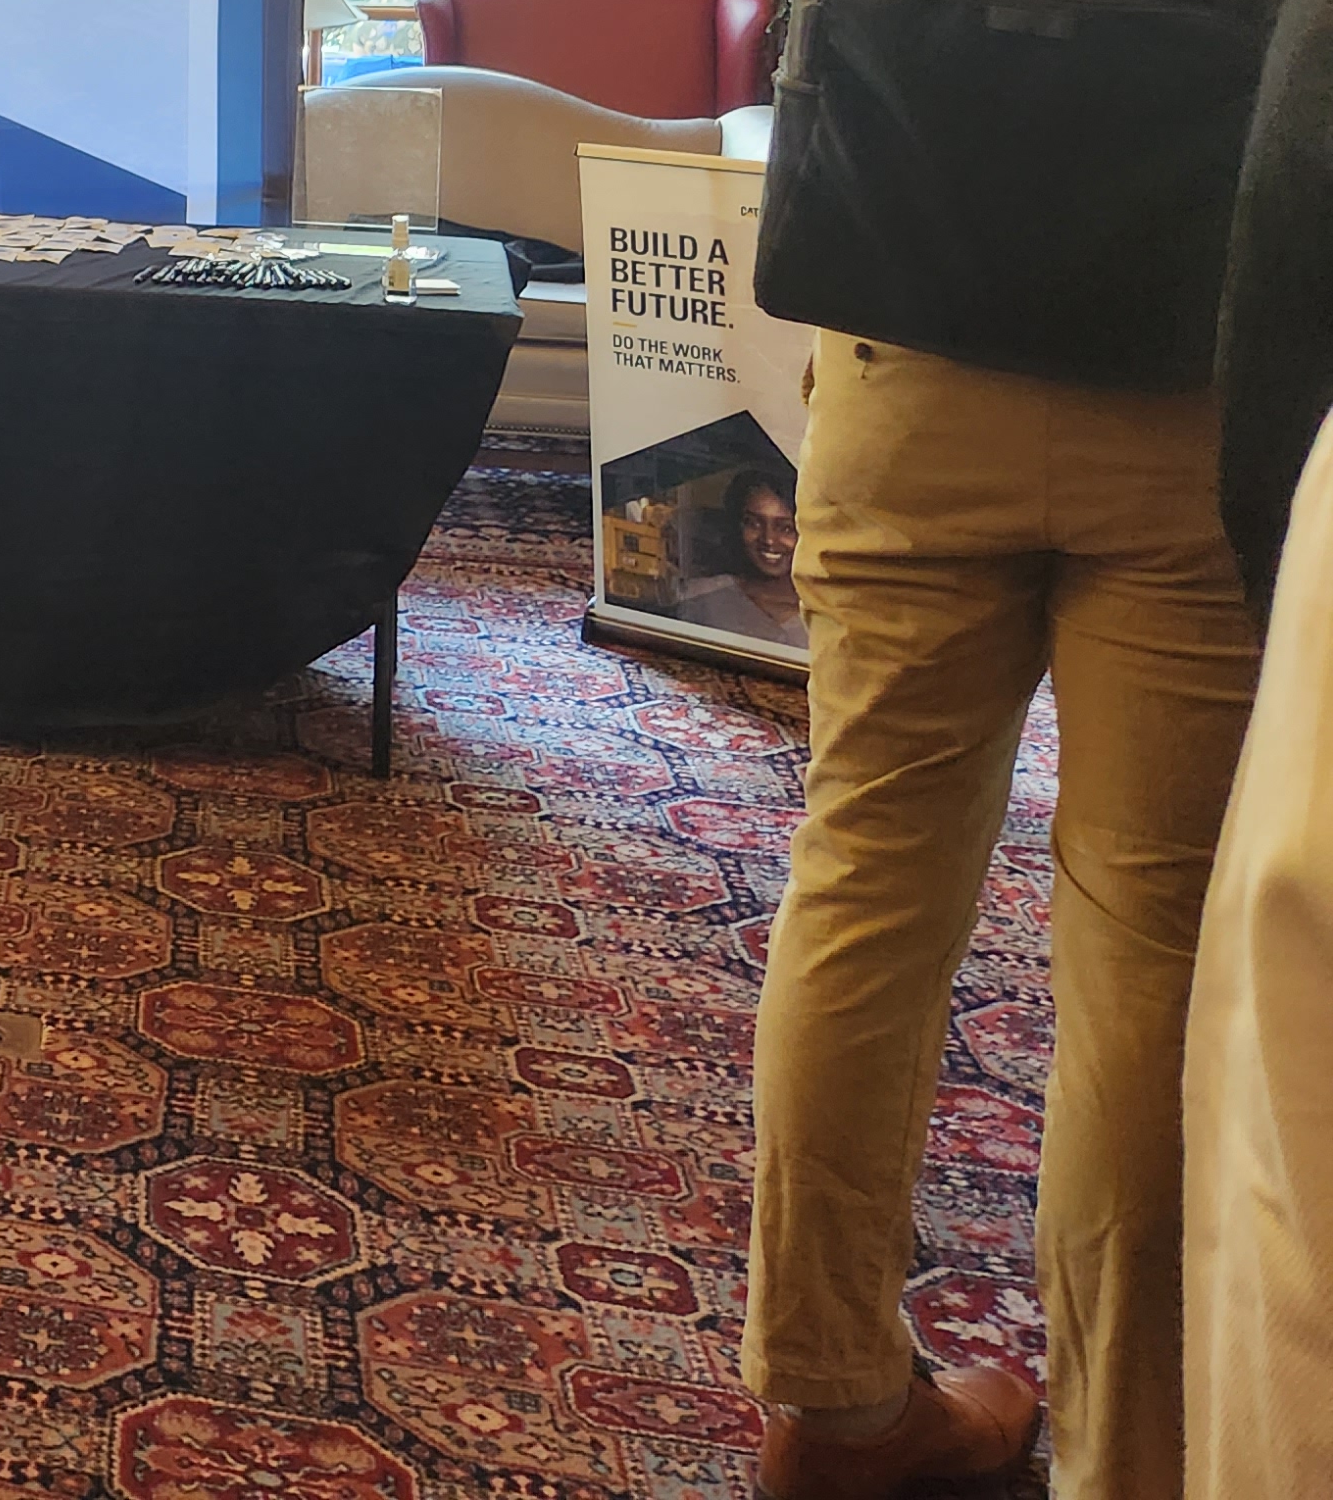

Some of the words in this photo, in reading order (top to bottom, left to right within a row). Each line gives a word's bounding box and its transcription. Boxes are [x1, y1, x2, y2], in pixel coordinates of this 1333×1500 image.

[610, 227, 698, 261] BUILD
[707, 238, 729, 266] A
[611, 257, 726, 296] BETTER
[611, 288, 734, 329] FUTURE.
[613, 334, 633, 349] DO
[637, 338, 668, 355] THE
[672, 342, 723, 363] WORK
[613, 351, 653, 370] THAT
[659, 358, 741, 384] MATTERS.
